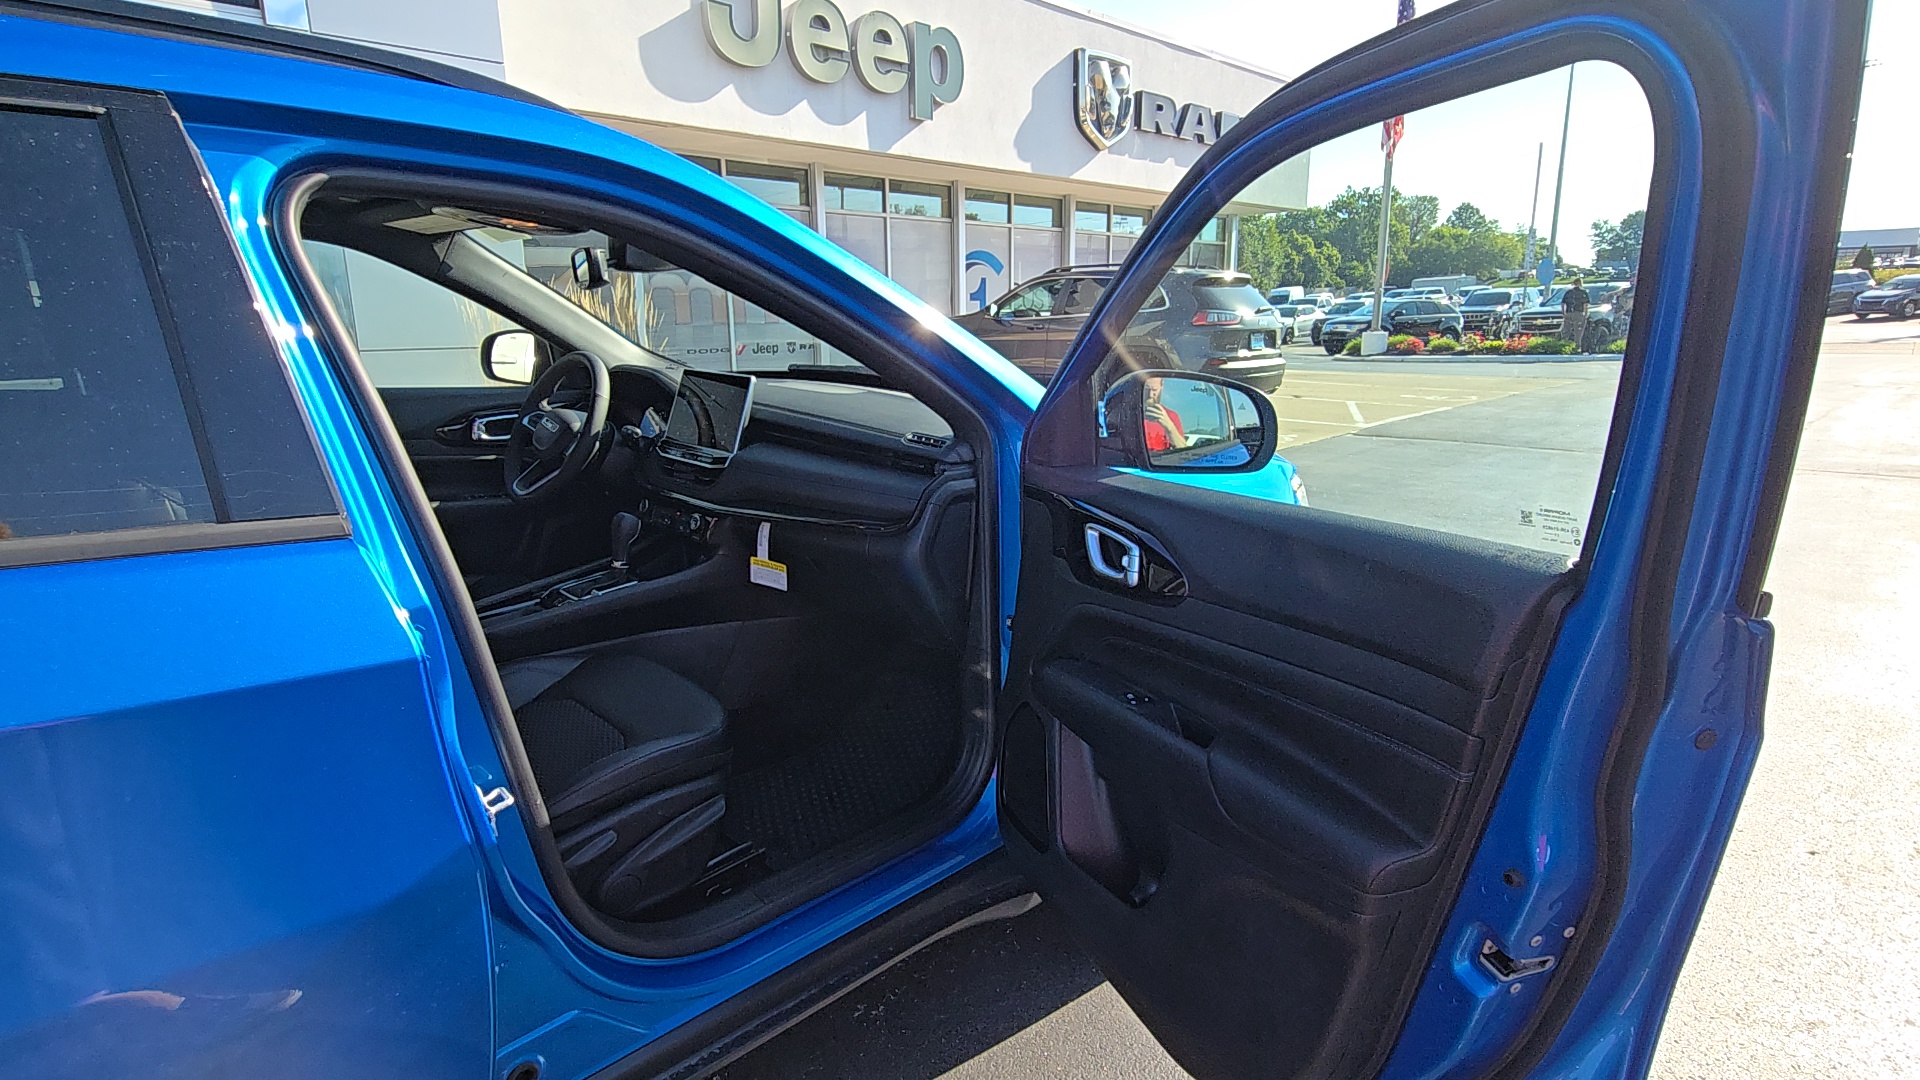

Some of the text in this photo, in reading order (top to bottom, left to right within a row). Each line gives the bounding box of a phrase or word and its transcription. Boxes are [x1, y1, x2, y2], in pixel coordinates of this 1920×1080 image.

[701, 0, 964, 121] Jeep
[686, 347, 731, 355] DODG
[752, 342, 779, 355] Jeep
